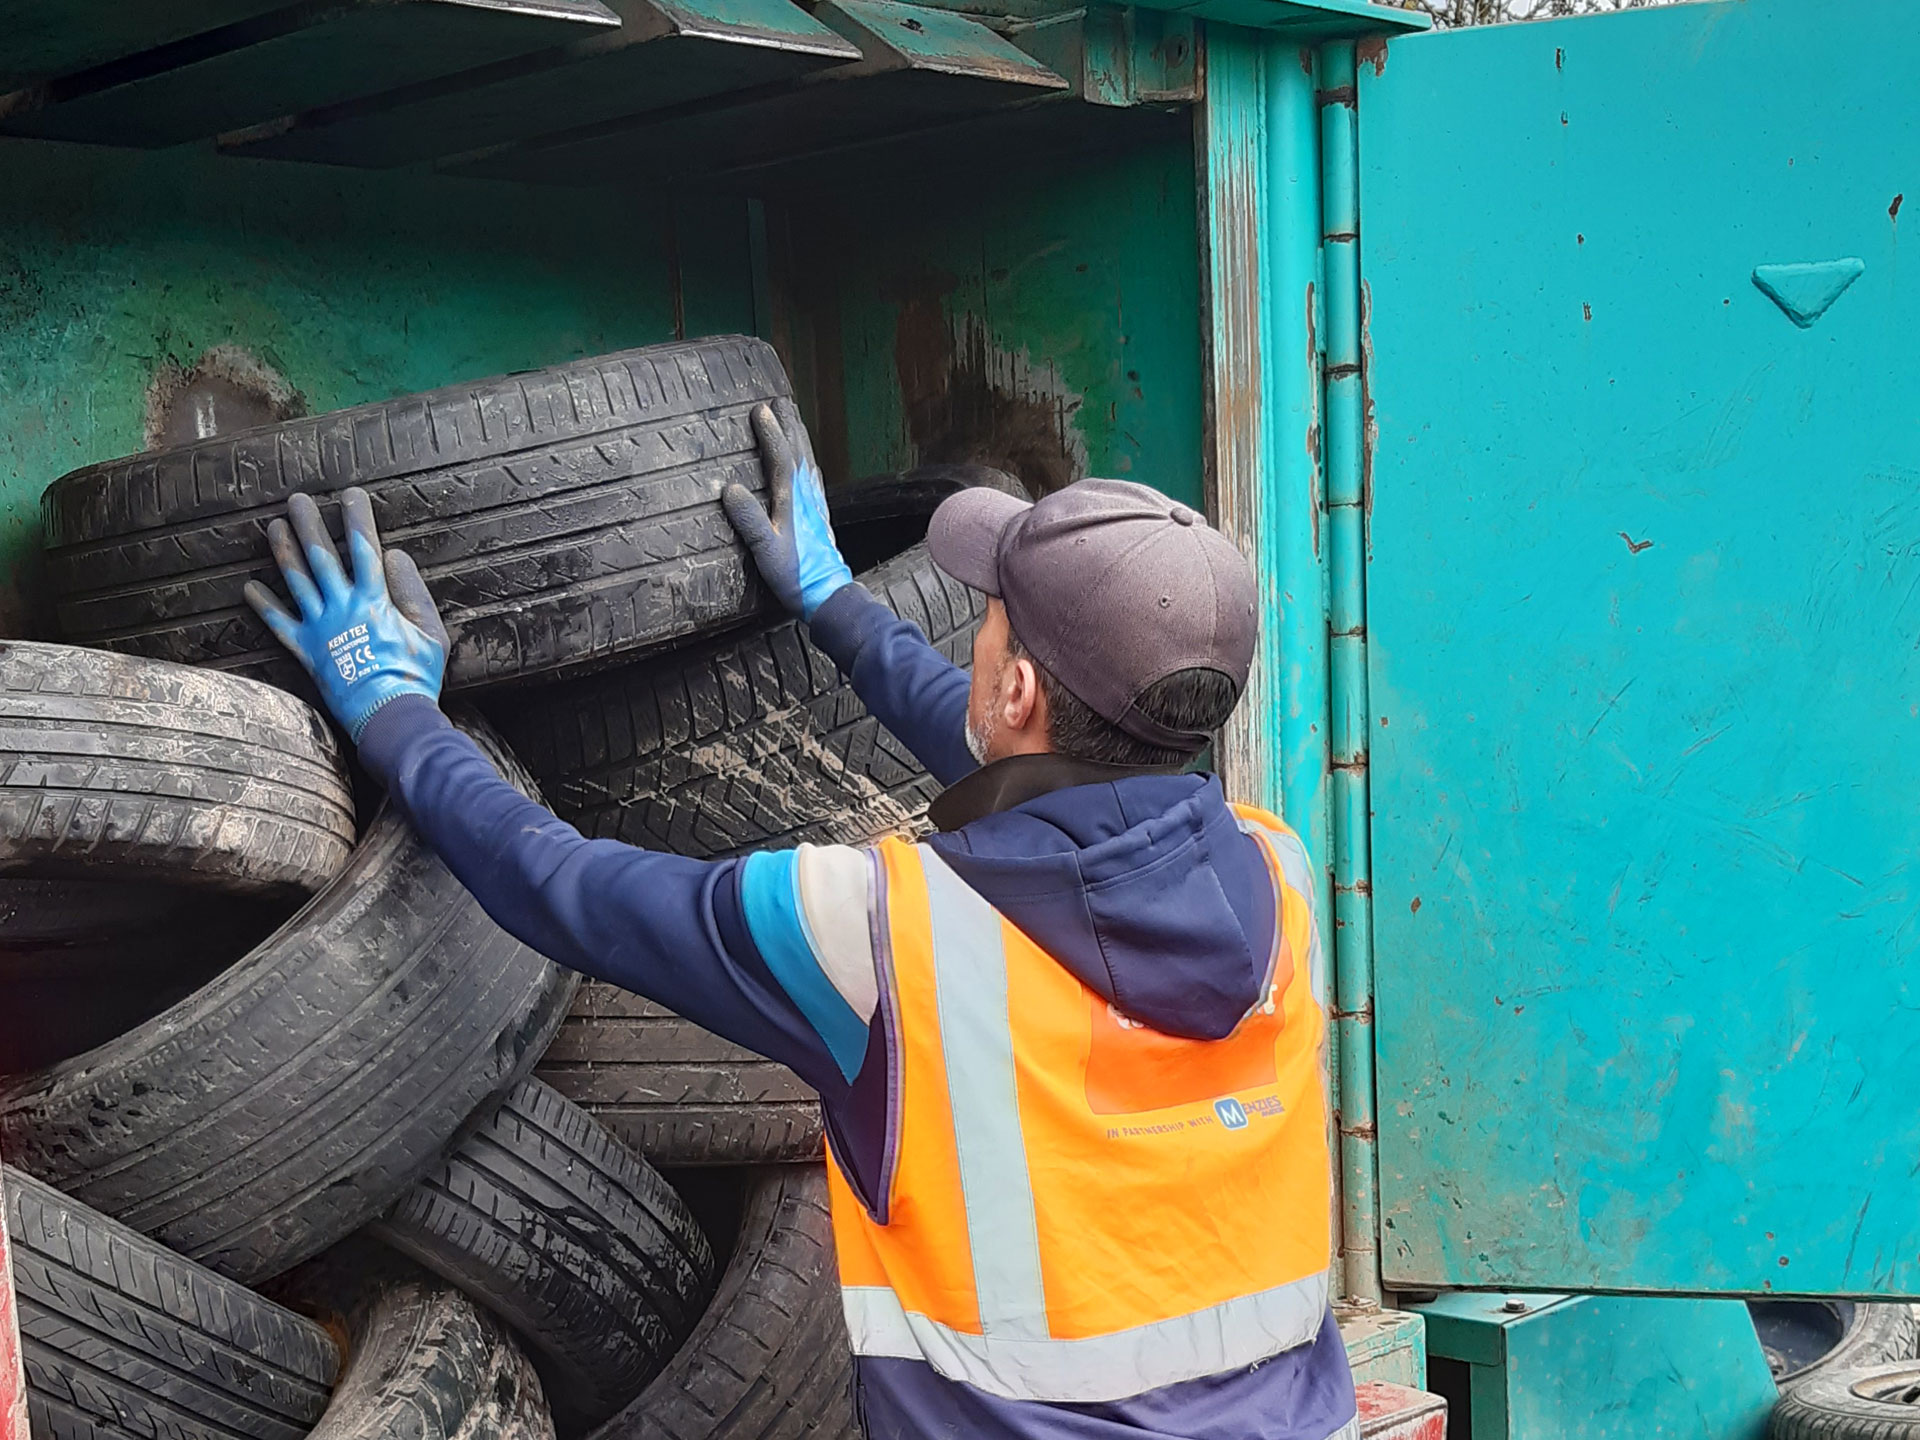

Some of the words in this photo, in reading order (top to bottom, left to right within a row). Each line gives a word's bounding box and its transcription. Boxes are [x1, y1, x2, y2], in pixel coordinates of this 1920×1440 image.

[328, 631, 349, 650] KENT
[349, 623, 369, 638] TEX
[1107, 1128, 1119, 1139] IN
[1123, 1121, 1185, 1137] PARTNERSHIP
[1187, 1115, 1214, 1128] WITH
[1218, 1095, 1281, 1126] MENZIES
